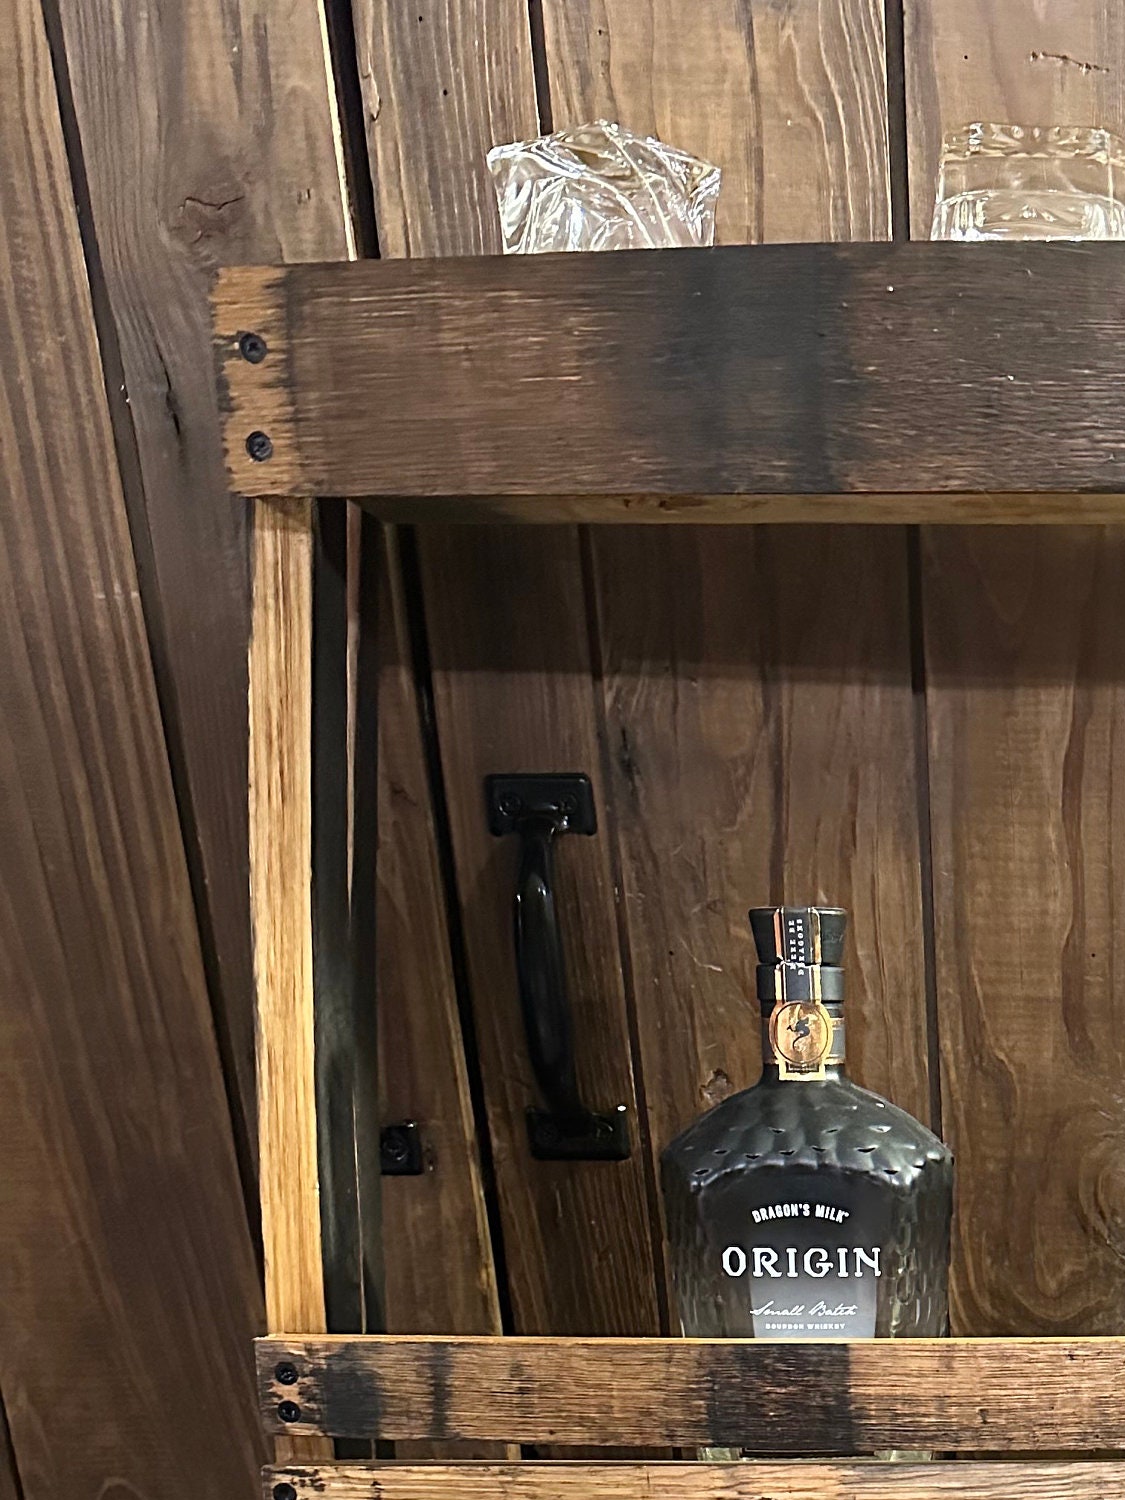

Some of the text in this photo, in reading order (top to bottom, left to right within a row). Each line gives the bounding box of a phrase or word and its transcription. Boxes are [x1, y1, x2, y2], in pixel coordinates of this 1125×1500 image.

[751, 1203, 811, 1223] DRAGON'S
[722, 1246, 882, 1278] ORIGIN
[750, 1300, 858, 1317] Small Batch
